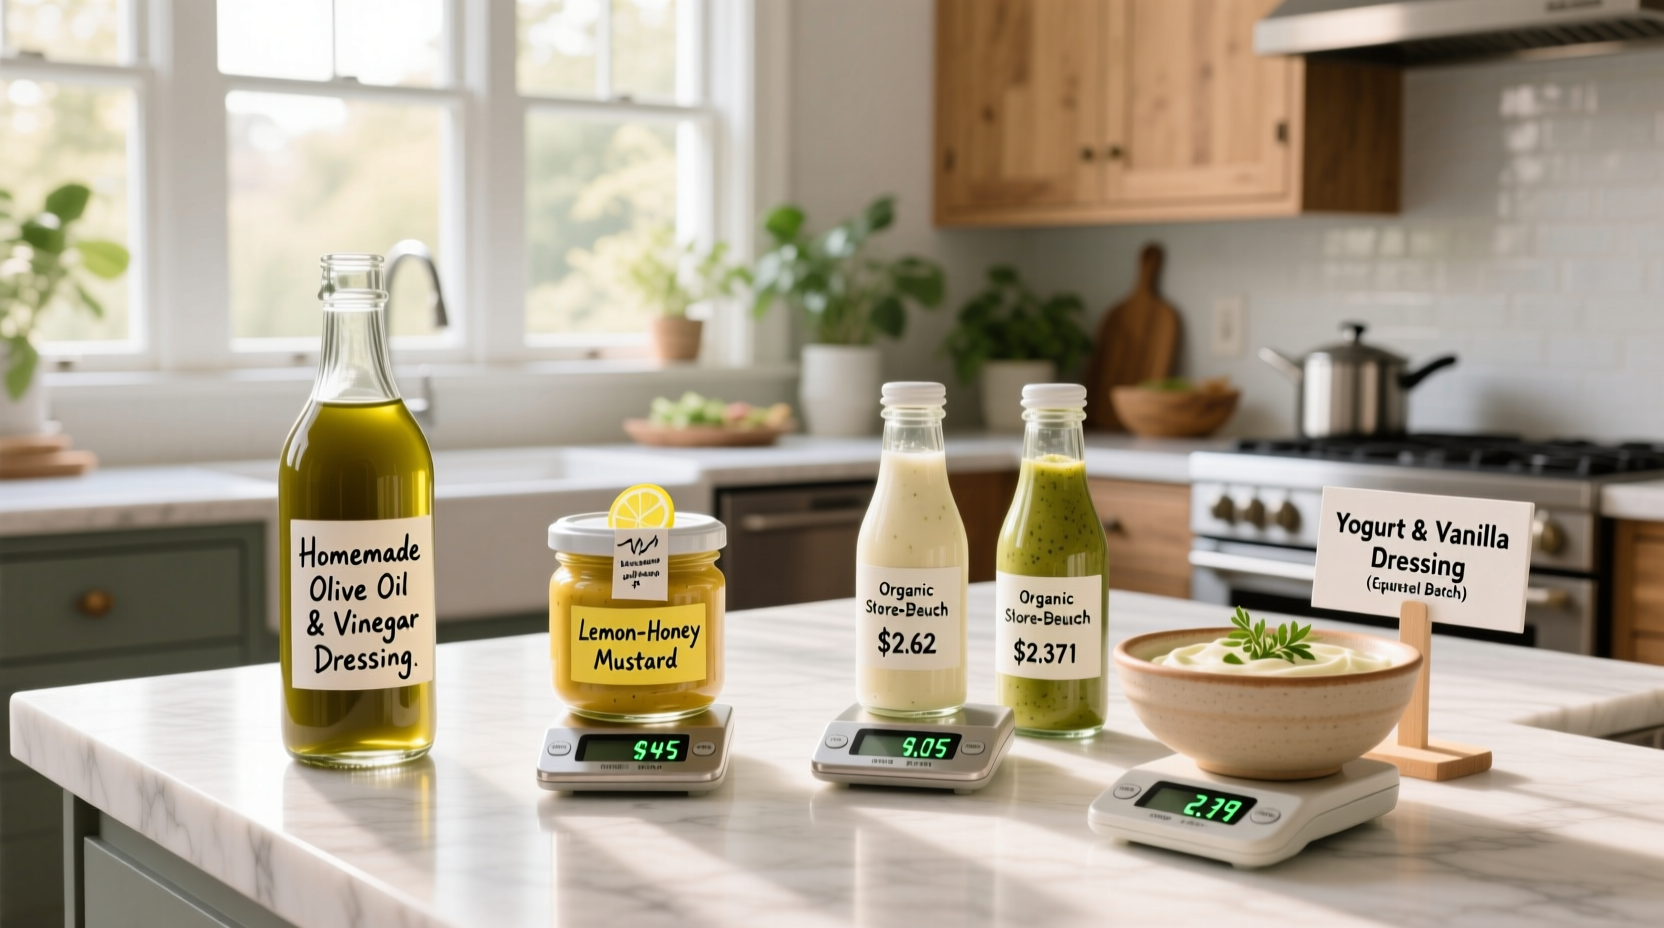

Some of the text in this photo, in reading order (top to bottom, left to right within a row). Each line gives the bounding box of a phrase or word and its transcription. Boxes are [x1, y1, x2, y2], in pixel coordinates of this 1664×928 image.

[1336, 512, 1509, 550] Yogurt & Vanilla
[299, 533, 420, 567] Homemade
[1371, 546, 1466, 584] Dressing
[309, 571, 407, 601] Olive Oil
[879, 581, 934, 601] Organic
[1019, 590, 1074, 608] Organic
[307, 609, 419, 644] & Vinegar
[579, 618, 700, 649] Lemon-Honey
[878, 626, 937, 658] $2.62
[314, 644, 418, 679] Dressing.
[594, 646, 678, 671] Mustard
[1013, 637, 1076, 666] $2.371
